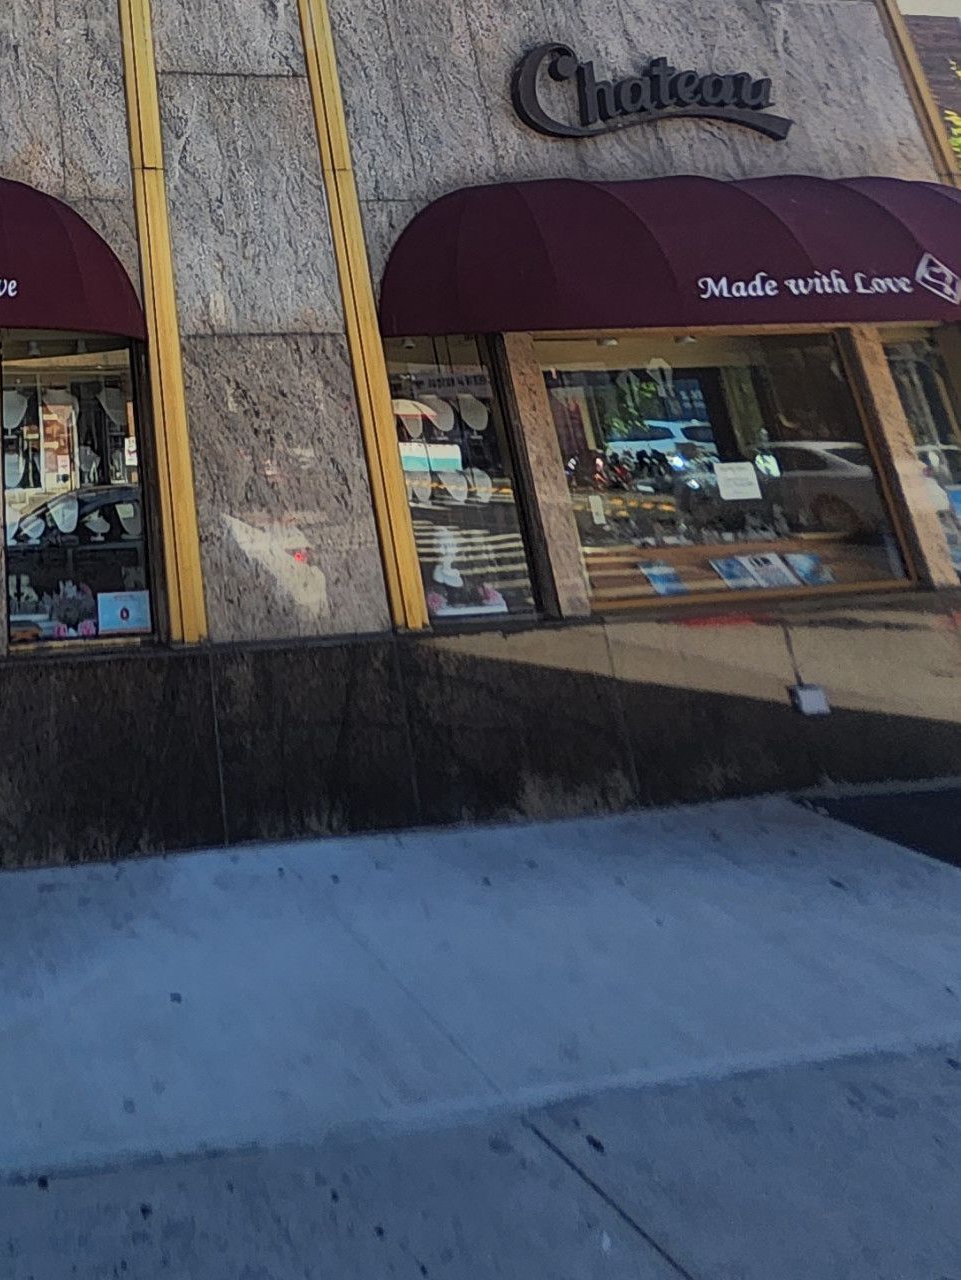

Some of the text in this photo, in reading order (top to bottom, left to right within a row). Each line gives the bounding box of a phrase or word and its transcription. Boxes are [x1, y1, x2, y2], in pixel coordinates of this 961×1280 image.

[510, 42, 794, 141] Chateau
[698, 269, 914, 299] Made with Love
